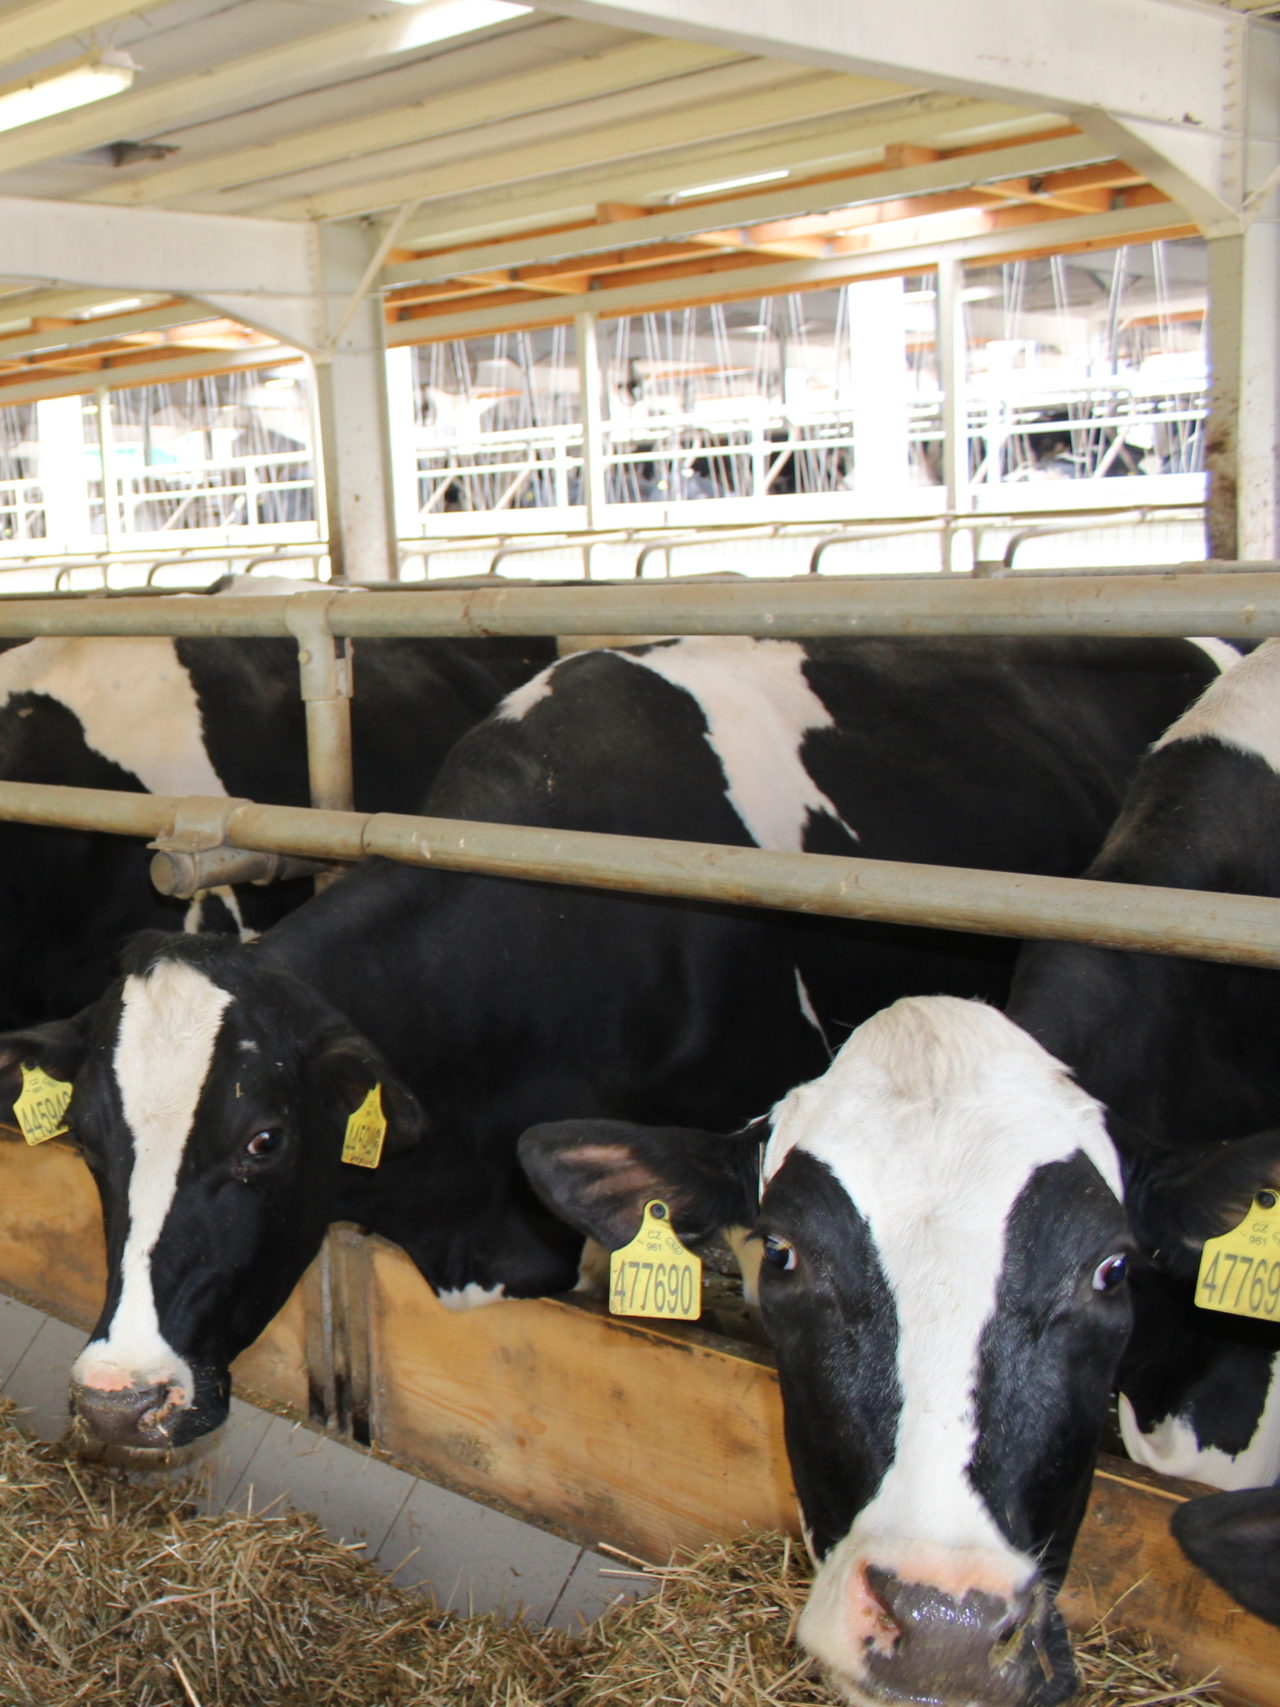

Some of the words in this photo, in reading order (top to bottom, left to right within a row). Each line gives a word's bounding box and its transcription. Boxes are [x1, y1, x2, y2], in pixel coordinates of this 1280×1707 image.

[1252, 1222, 1270, 1233] CZ
[648, 1231, 661, 1240] CZ
[614, 1260, 693, 1315] 477690
